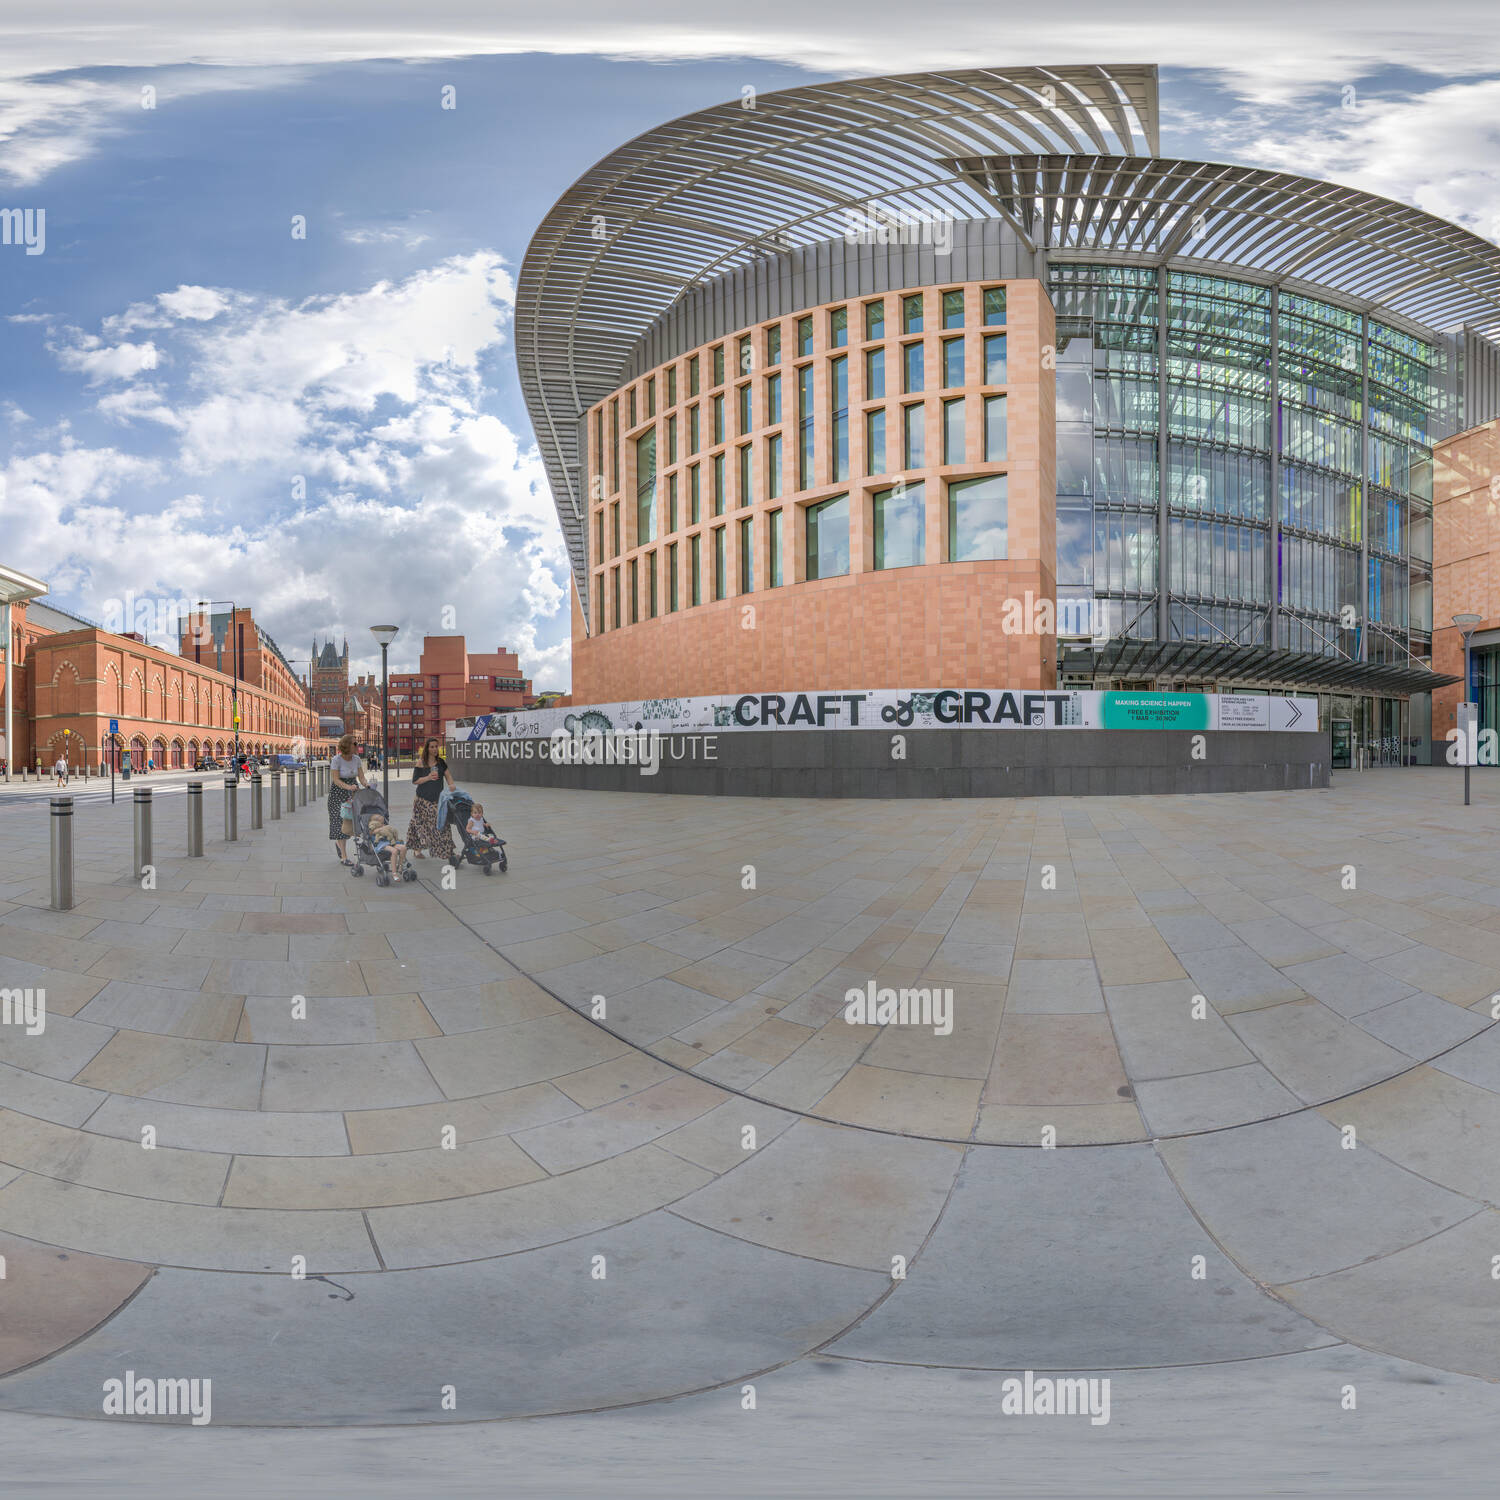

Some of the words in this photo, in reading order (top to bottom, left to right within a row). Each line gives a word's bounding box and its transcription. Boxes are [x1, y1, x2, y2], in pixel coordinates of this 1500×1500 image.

[735, 694, 867, 727] CRAFT
[881, 698, 914, 727] &
[933, 690, 1070, 726] GRAFT
[450, 742, 471, 759] THE
[474, 741, 534, 759] FRANCIS
[598, 735, 718, 760] INSTITUTE
